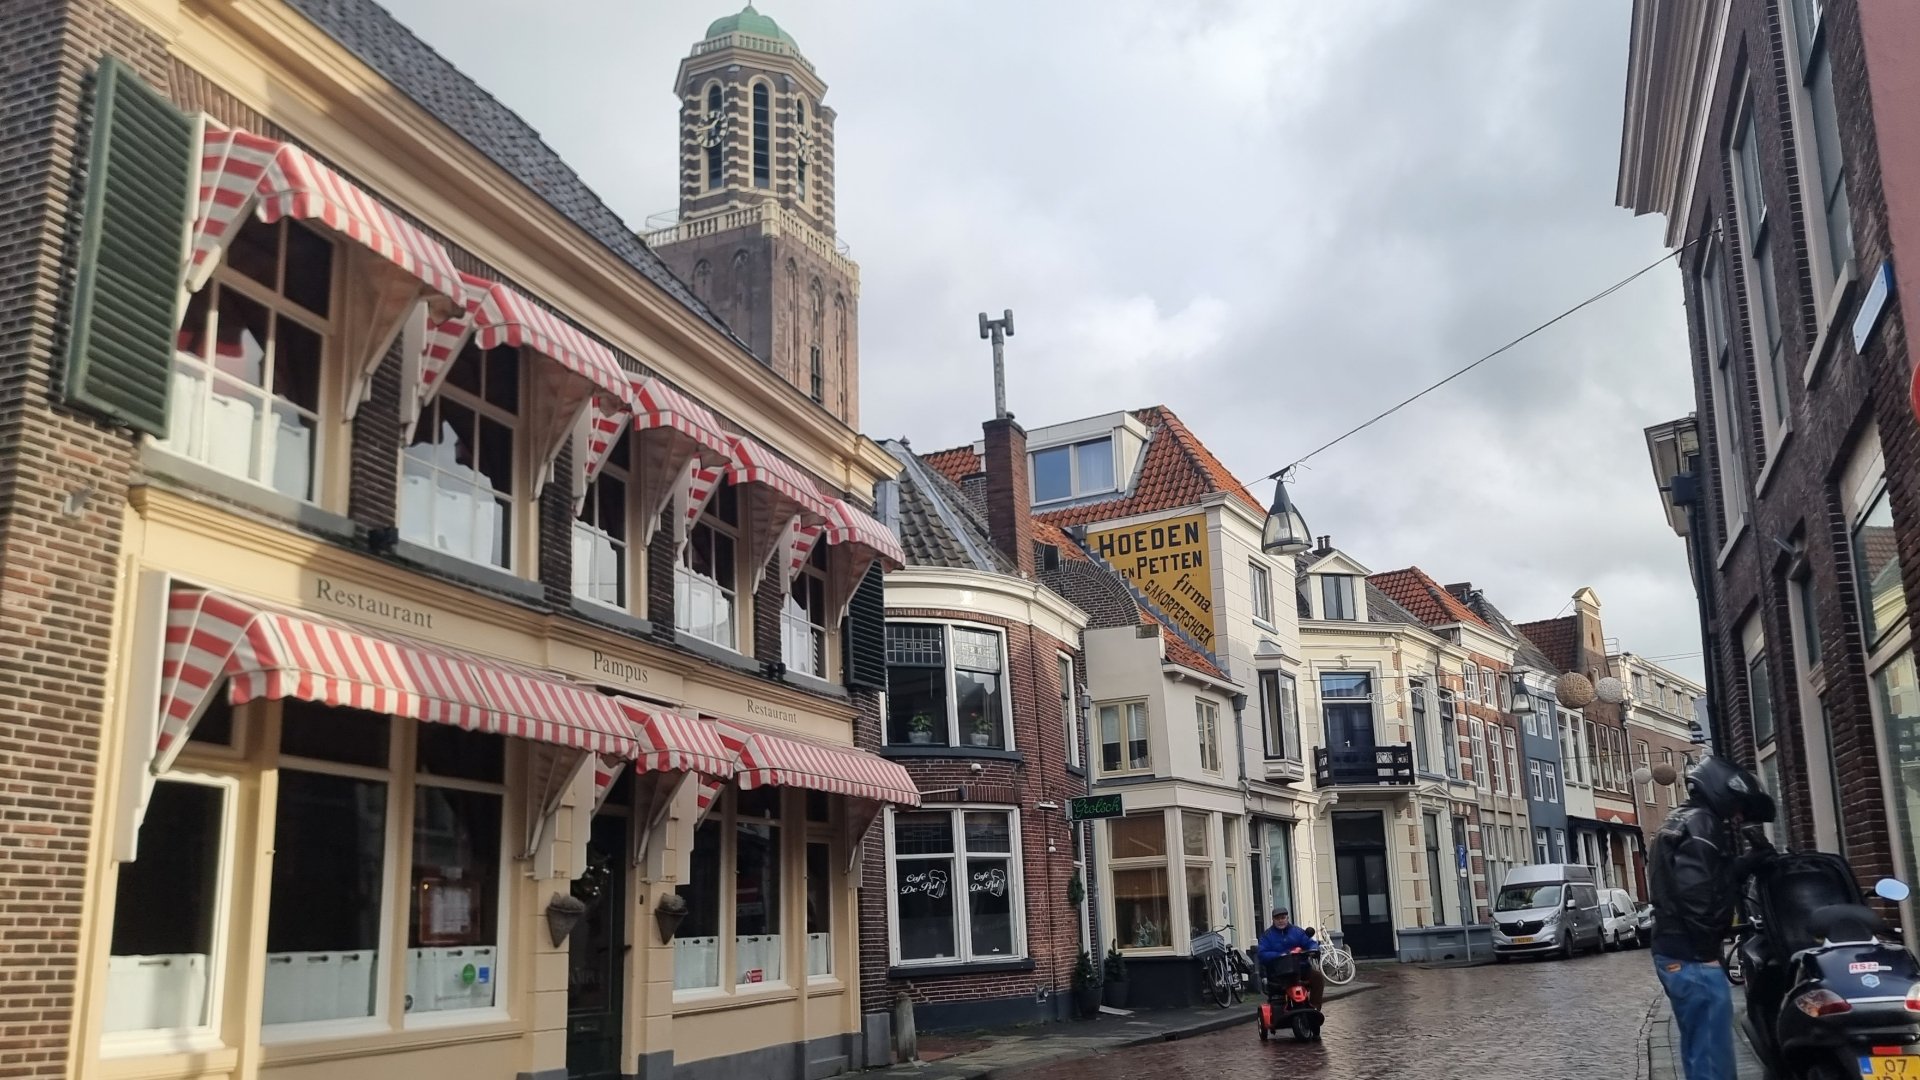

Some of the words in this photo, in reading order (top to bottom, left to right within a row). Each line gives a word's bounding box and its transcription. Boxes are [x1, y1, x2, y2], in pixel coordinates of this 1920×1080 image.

[1098, 521, 1199, 558] HOEDEN
[1121, 567, 1135, 579] EN
[1136, 550, 1203, 579] PETTEN
[316, 578, 433, 629] Restaurant
[1172, 573, 1211, 613] firma
[593, 650, 648, 683] Pampus
[746, 699, 798, 724] Restaurant
[1073, 796, 1121, 818] Grolsch
[900, 885, 918, 895] De
[969, 883, 984, 892] De
[1884, 1059, 1908, 1073] 07
